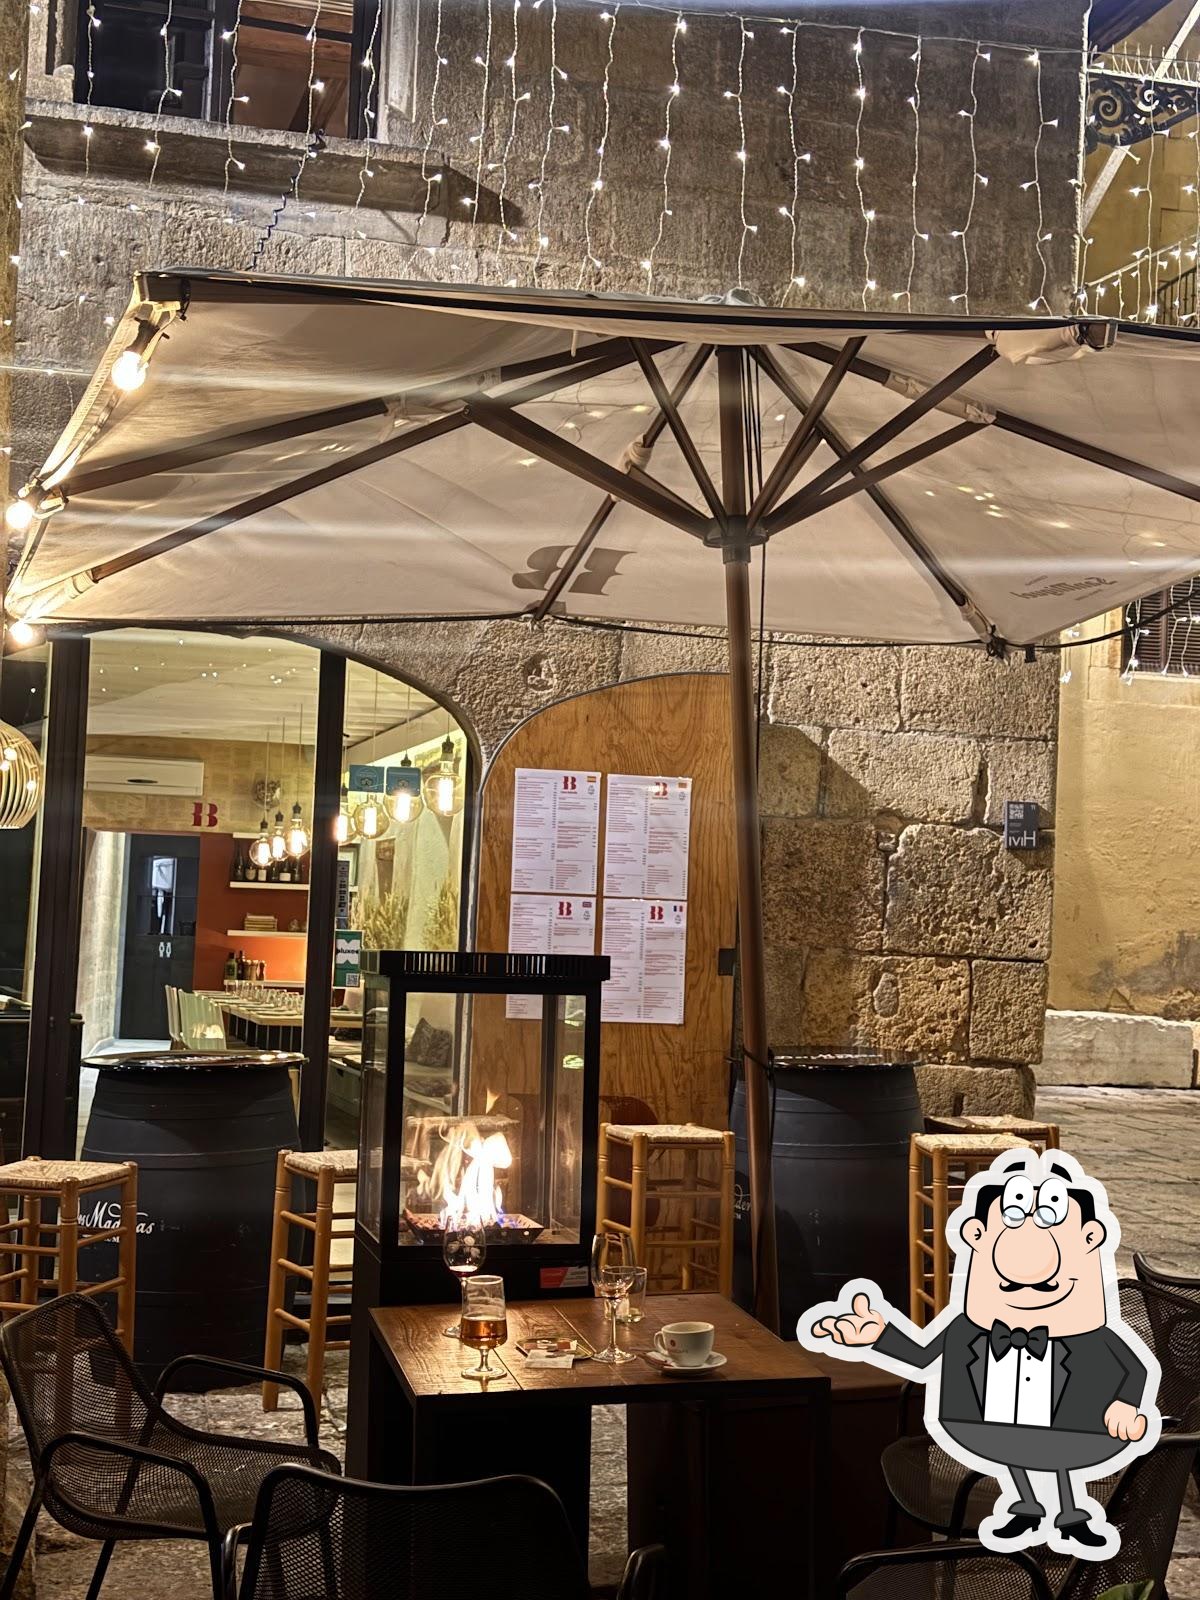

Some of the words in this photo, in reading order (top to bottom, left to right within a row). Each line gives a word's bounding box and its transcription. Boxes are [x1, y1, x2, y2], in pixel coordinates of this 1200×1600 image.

[563, 776, 577, 790] B
[192, 802, 218, 827] B
[558, 901, 572, 916] B
[650, 906, 664, 920] B
